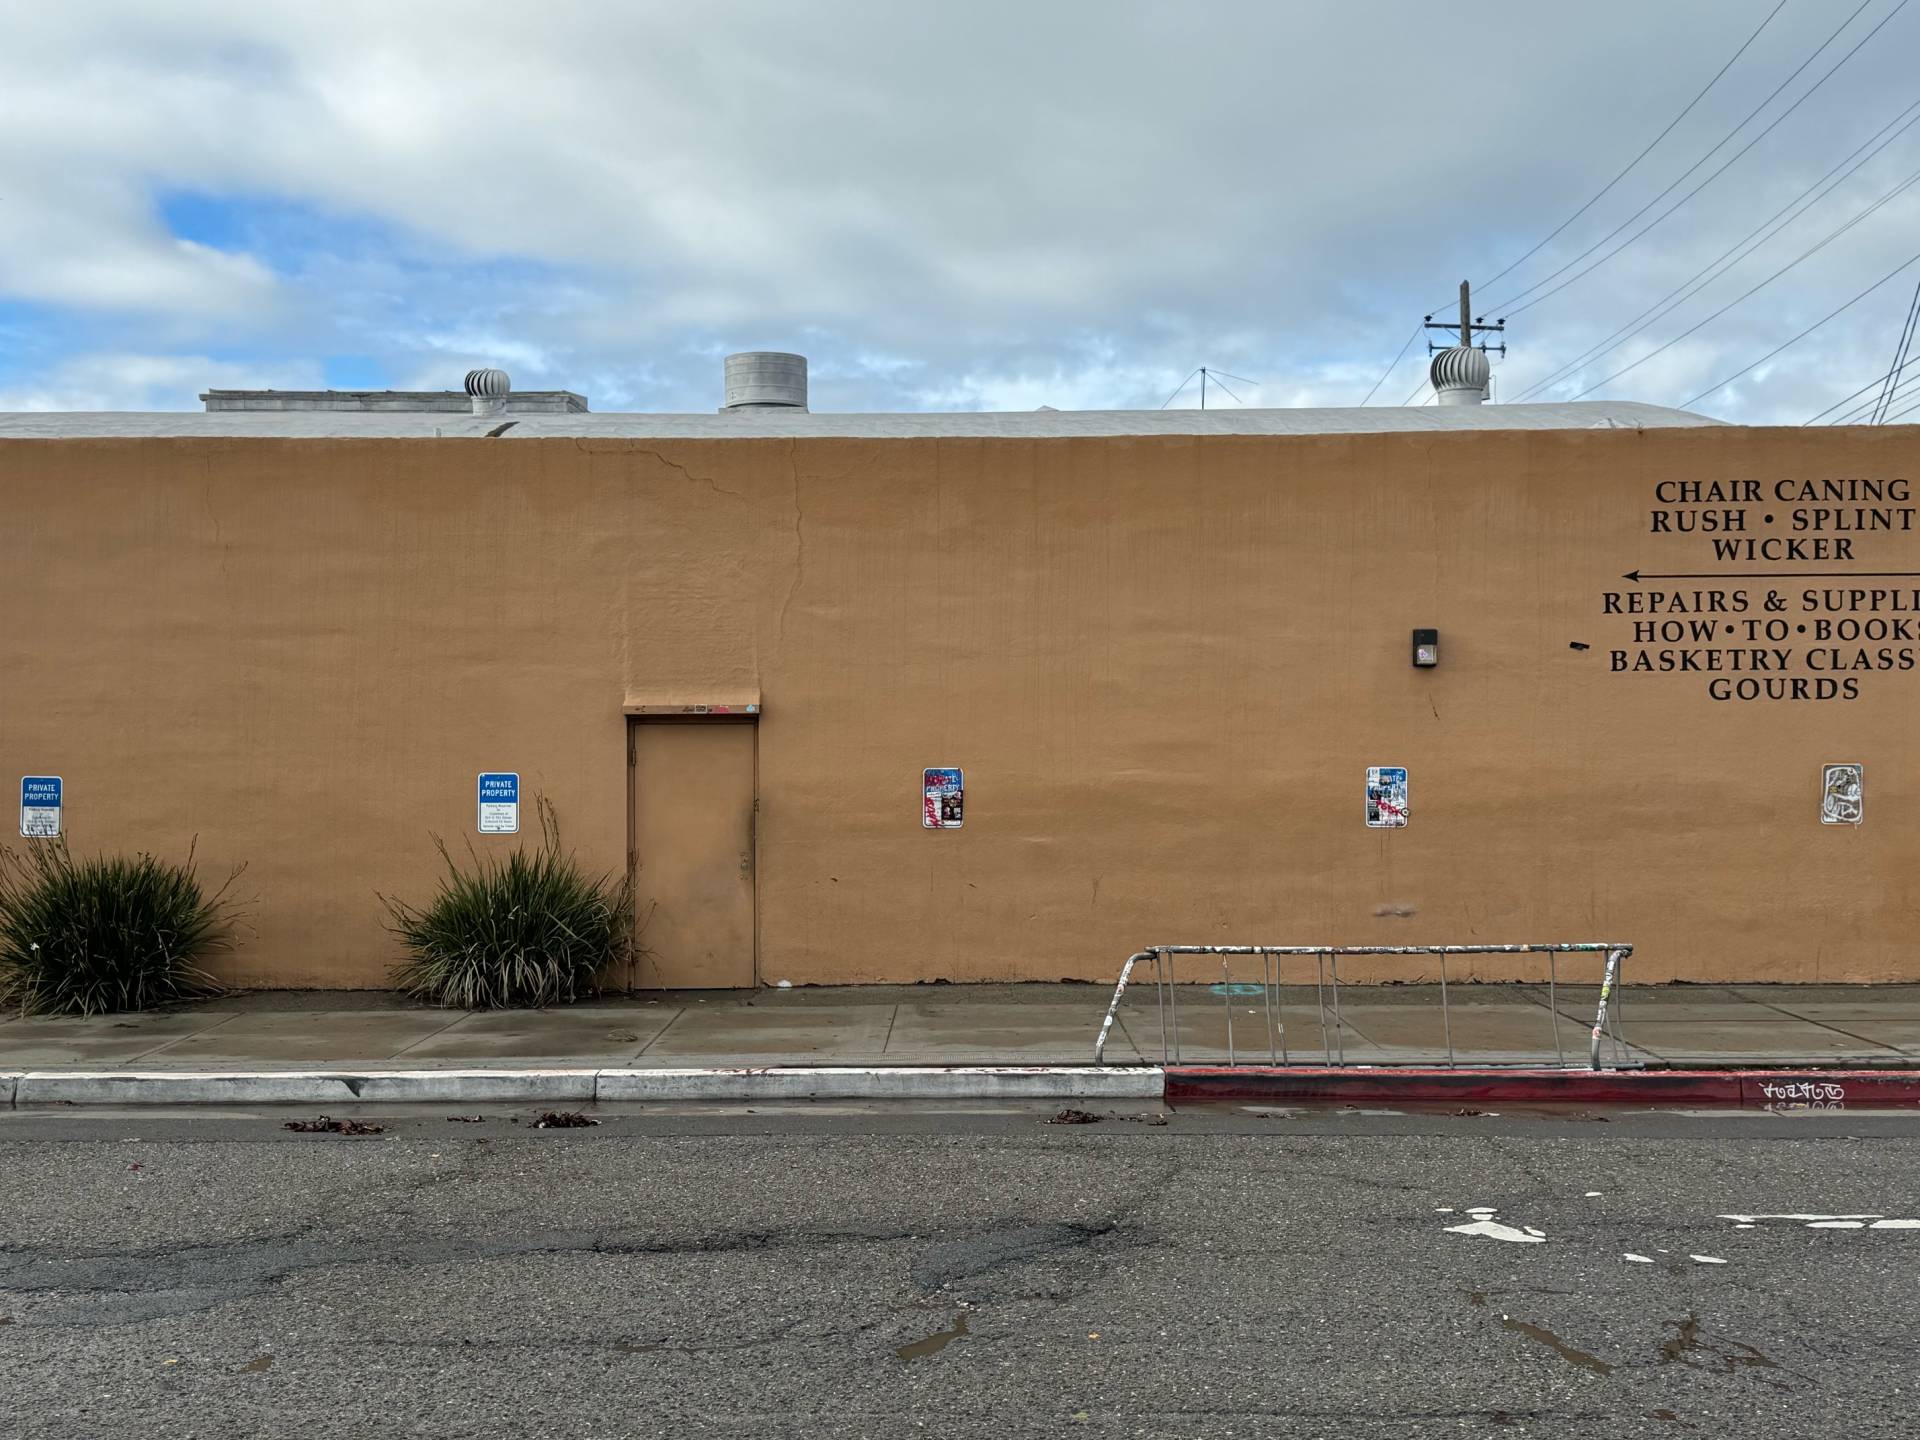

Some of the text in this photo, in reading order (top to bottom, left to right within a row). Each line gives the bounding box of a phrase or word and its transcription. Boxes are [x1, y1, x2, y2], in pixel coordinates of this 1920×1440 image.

[1655, 479, 1911, 503] CHAIR CANING
[1650, 508, 1916, 532] RUSH SPLINT
[1712, 538, 1855, 561] WICKER
[1602, 591, 1749, 614] REPAIRS
[1763, 590, 1788, 612] &
[1633, 619, 1920, 643] HOW TO BOOK
[1610, 648, 1920, 672] BASKETRY CLASS
[1708, 677, 1859, 701] GOURDS
[28, 784, 56, 792] PRIVATE
[481, 789, 516, 797] PROPERTY
[485, 780, 513, 788] PRIVATE
[24, 793, 59, 801] PROPERTY
